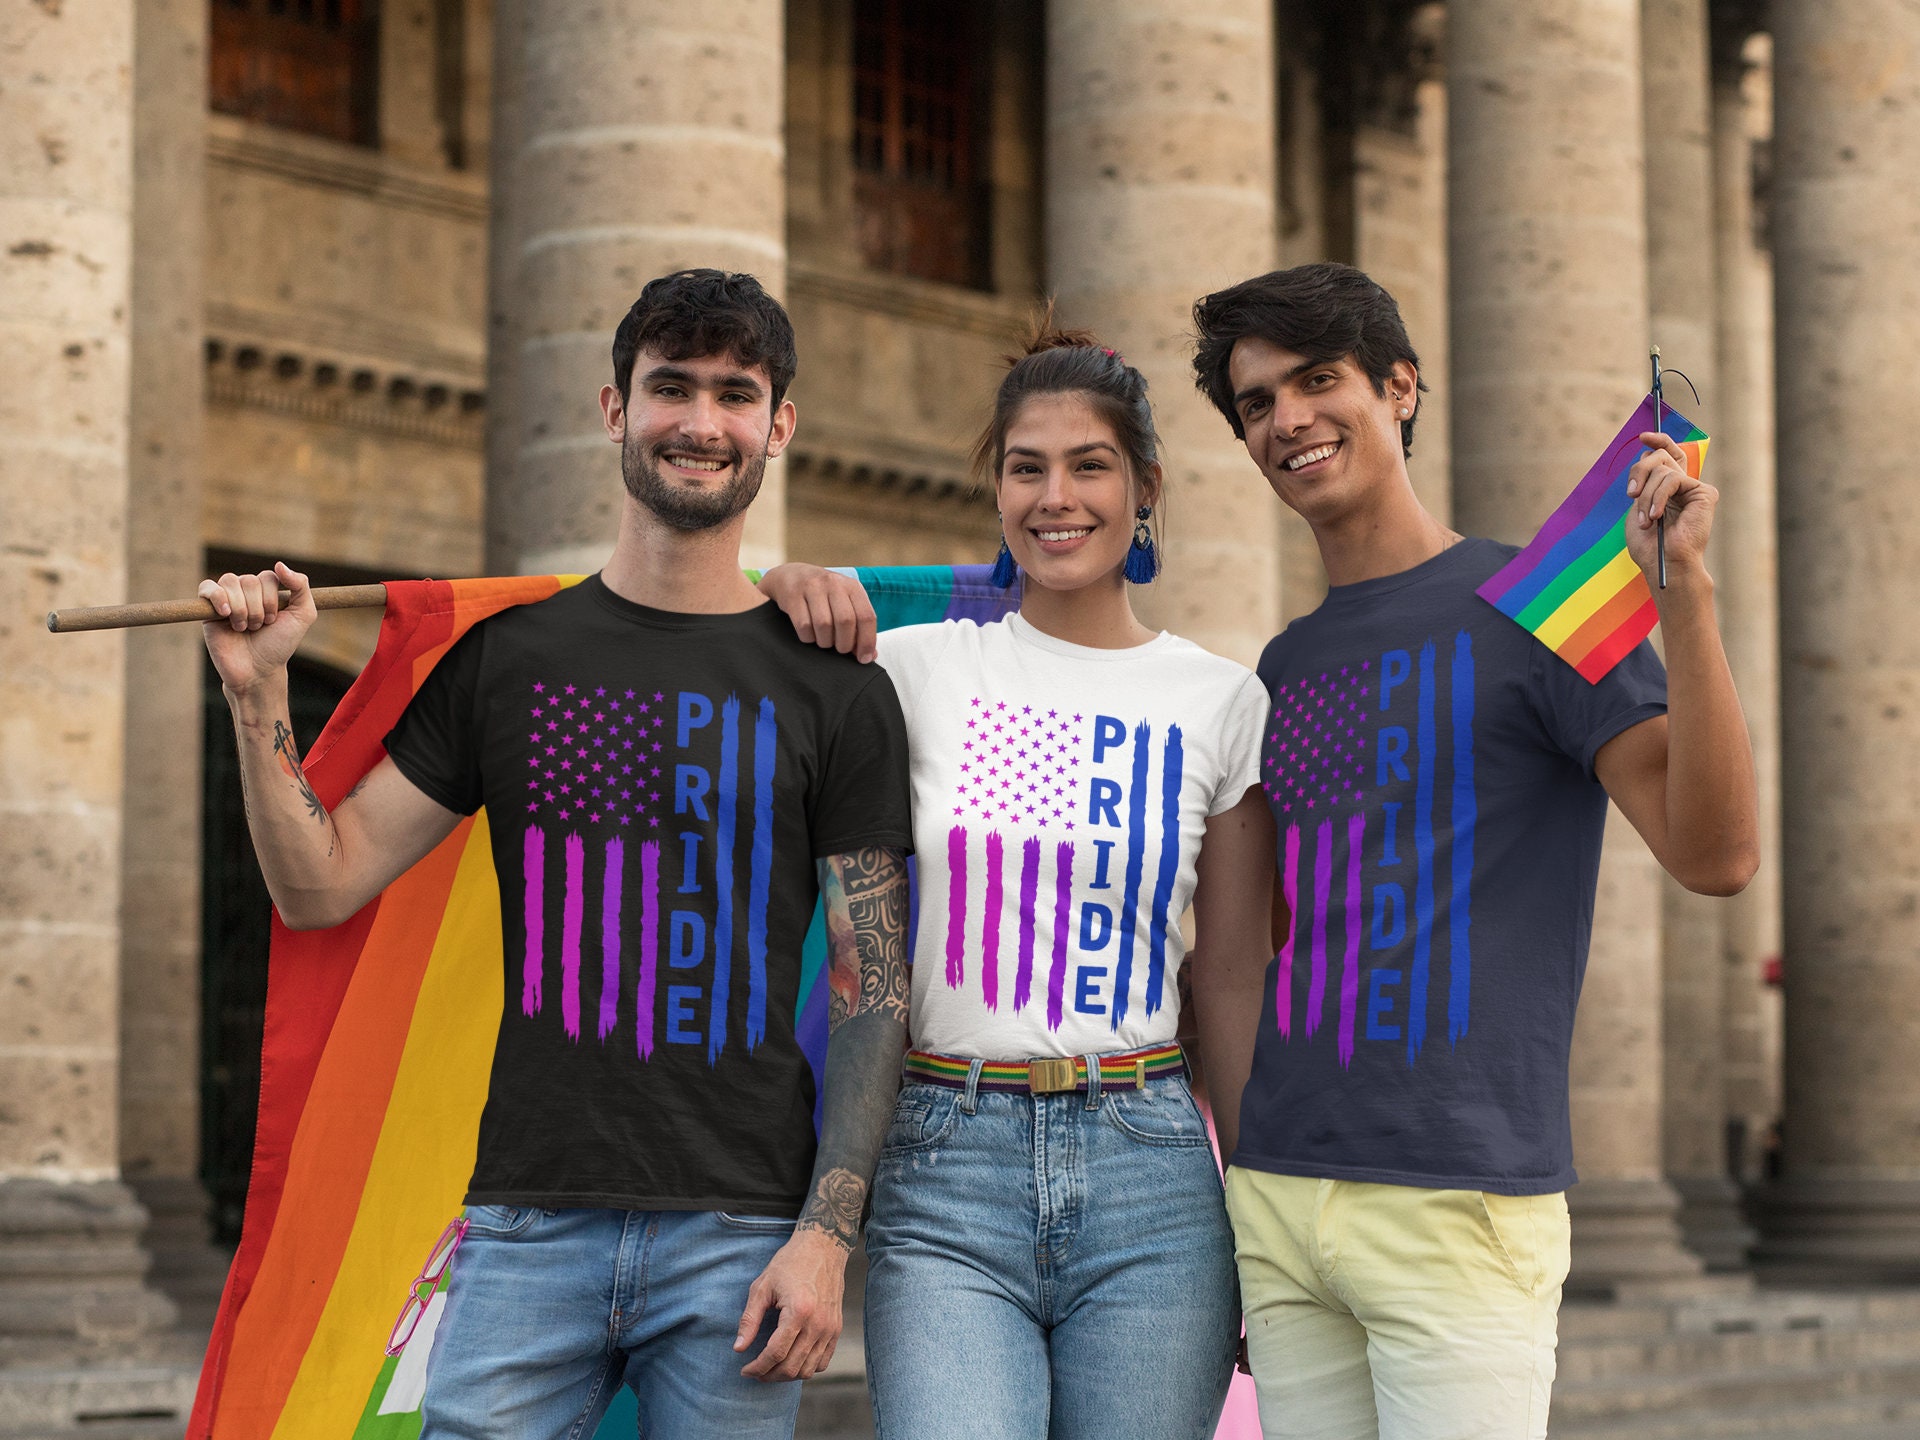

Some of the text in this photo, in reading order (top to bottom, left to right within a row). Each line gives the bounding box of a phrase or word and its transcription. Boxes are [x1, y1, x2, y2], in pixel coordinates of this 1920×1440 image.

[667, 692, 713, 1044] PRIDE
[1075, 715, 1126, 1015] PRIDE
[1366, 649, 1411, 1040] PRIDE
